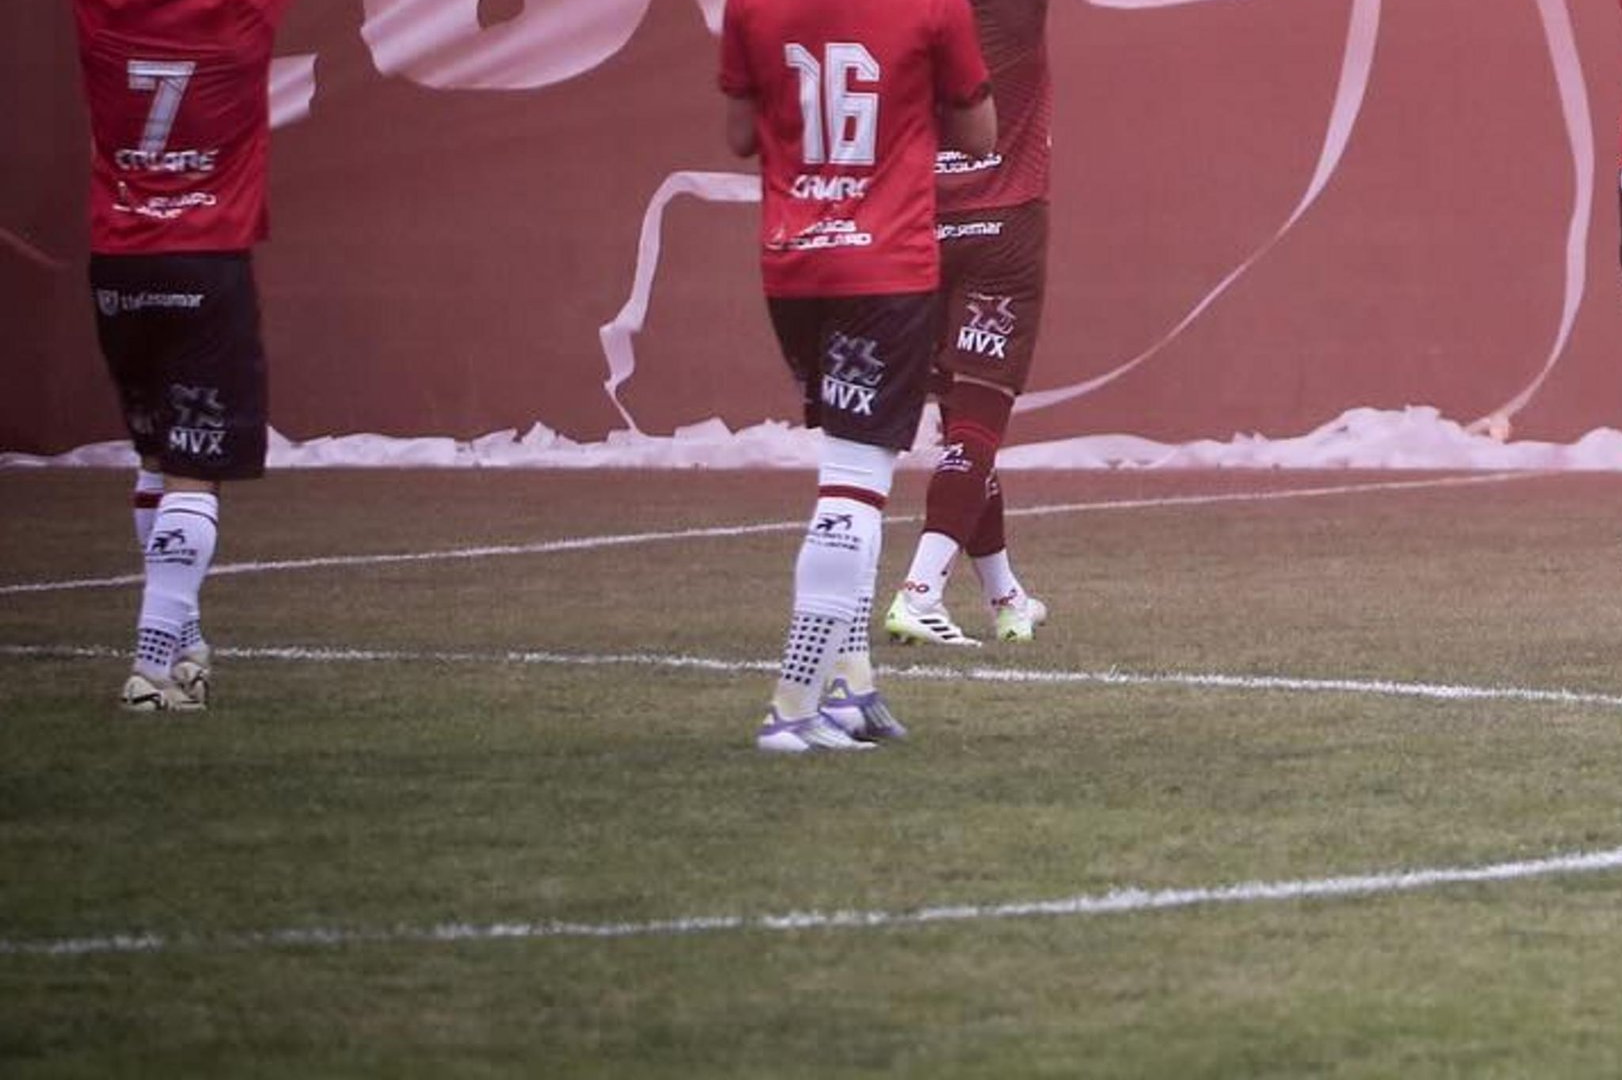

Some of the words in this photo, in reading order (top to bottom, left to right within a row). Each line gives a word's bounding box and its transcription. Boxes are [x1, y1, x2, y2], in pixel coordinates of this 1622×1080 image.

[126, 60, 197, 154] 7
[784, 42, 880, 166] 16
[957, 327, 1007, 359] MVX
[822, 374, 877, 416] MVX
[168, 427, 226, 454] MVX
